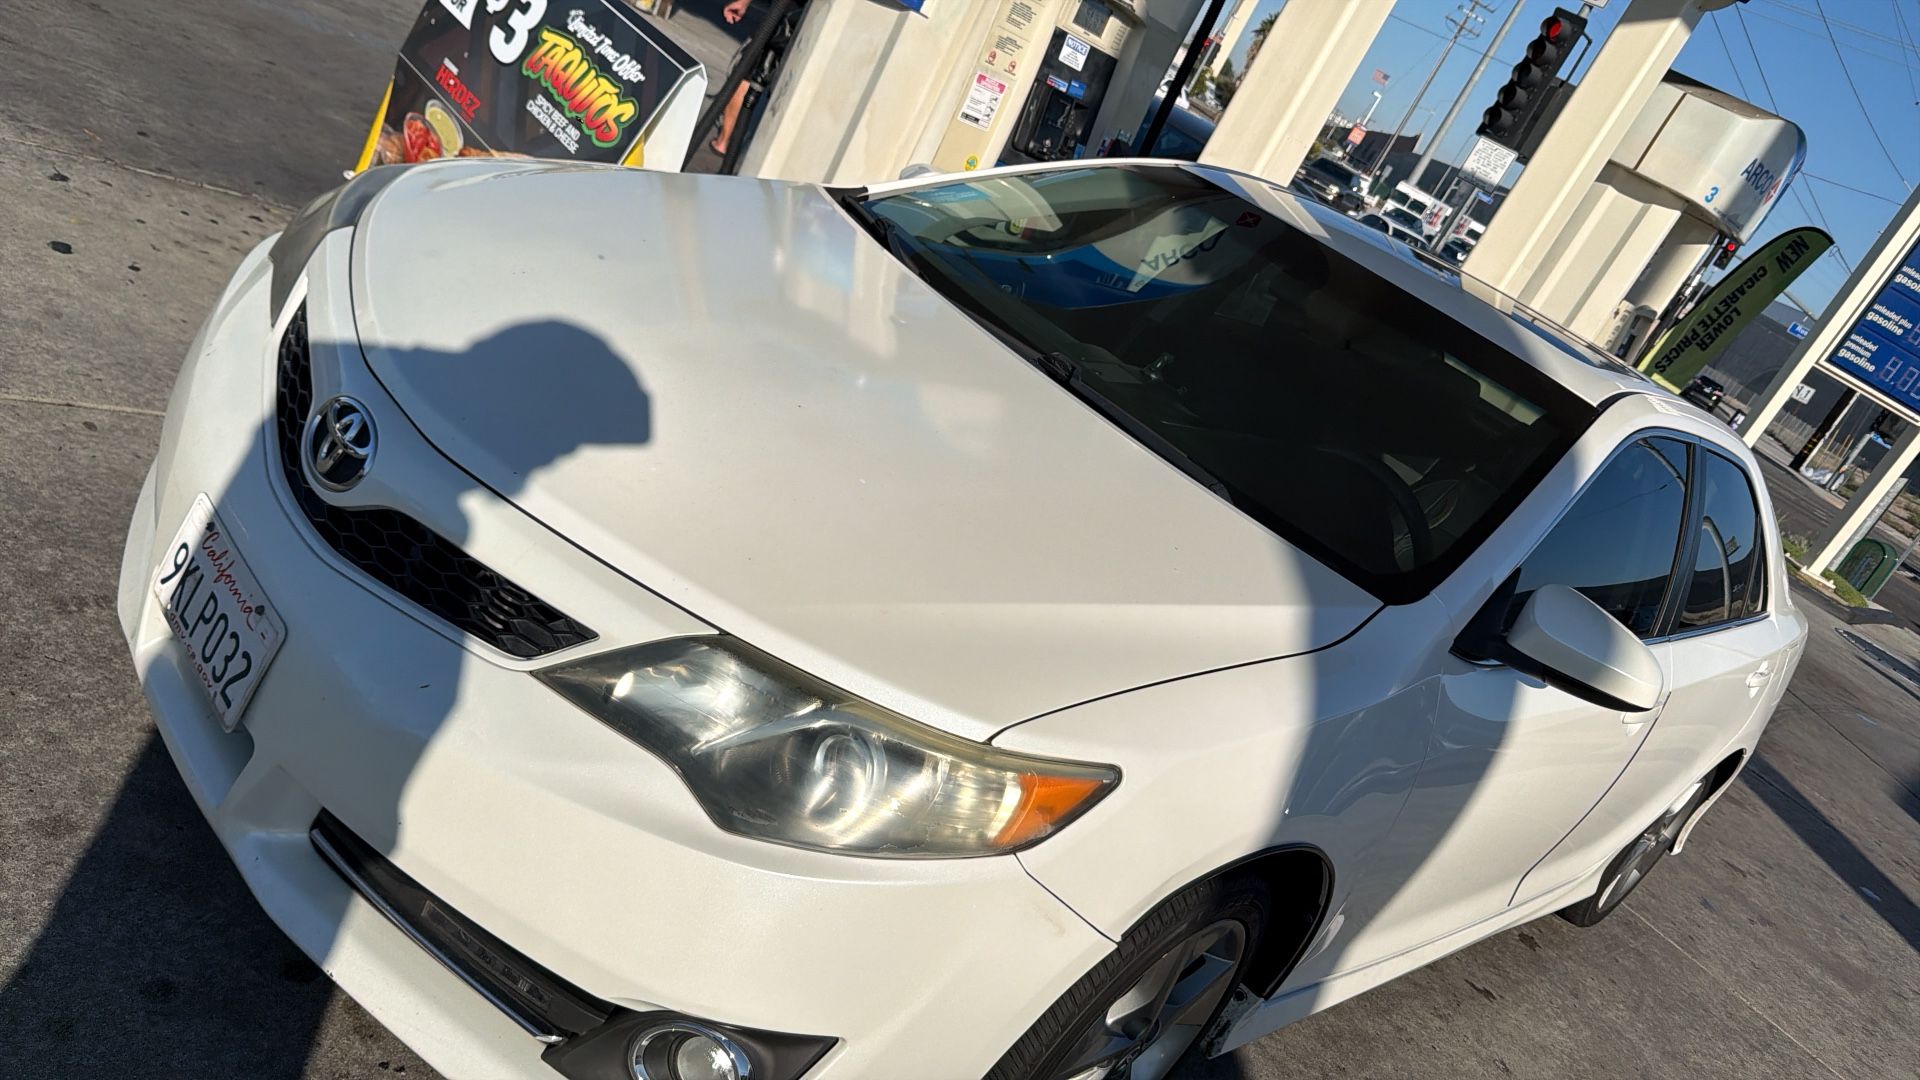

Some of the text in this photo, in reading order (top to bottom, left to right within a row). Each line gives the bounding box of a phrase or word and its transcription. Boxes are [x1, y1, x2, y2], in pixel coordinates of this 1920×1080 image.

[594, 36, 621, 63] Time
[611, 54, 646, 83] Offer
[435, 63, 481, 119] HERDEZ
[523, 28, 637, 145] TAQUITOS
[526, 99, 553, 129] CHICKEN
[553, 127, 580, 155] CHEESE
[535, 94, 581, 142] SPICY BEEF AND
[1704, 186, 1719, 203] 3
[1739, 157, 1777, 196] ARCO
[1775, 234, 1810, 273] NEW
[1654, 264, 1768, 373] CIGARETTE PRICES
[1696, 307, 1742, 351] LOWER
[1866, 311, 1904, 336] gasoline
[1873, 303, 1914, 330] unleaded plus
[1837, 348, 1876, 372] gasoline
[1843, 340, 1872, 359] premium
[1850, 333, 1879, 352] unleaded
[201, 531, 254, 632] California
[160, 542, 253, 710] 9KLP032
